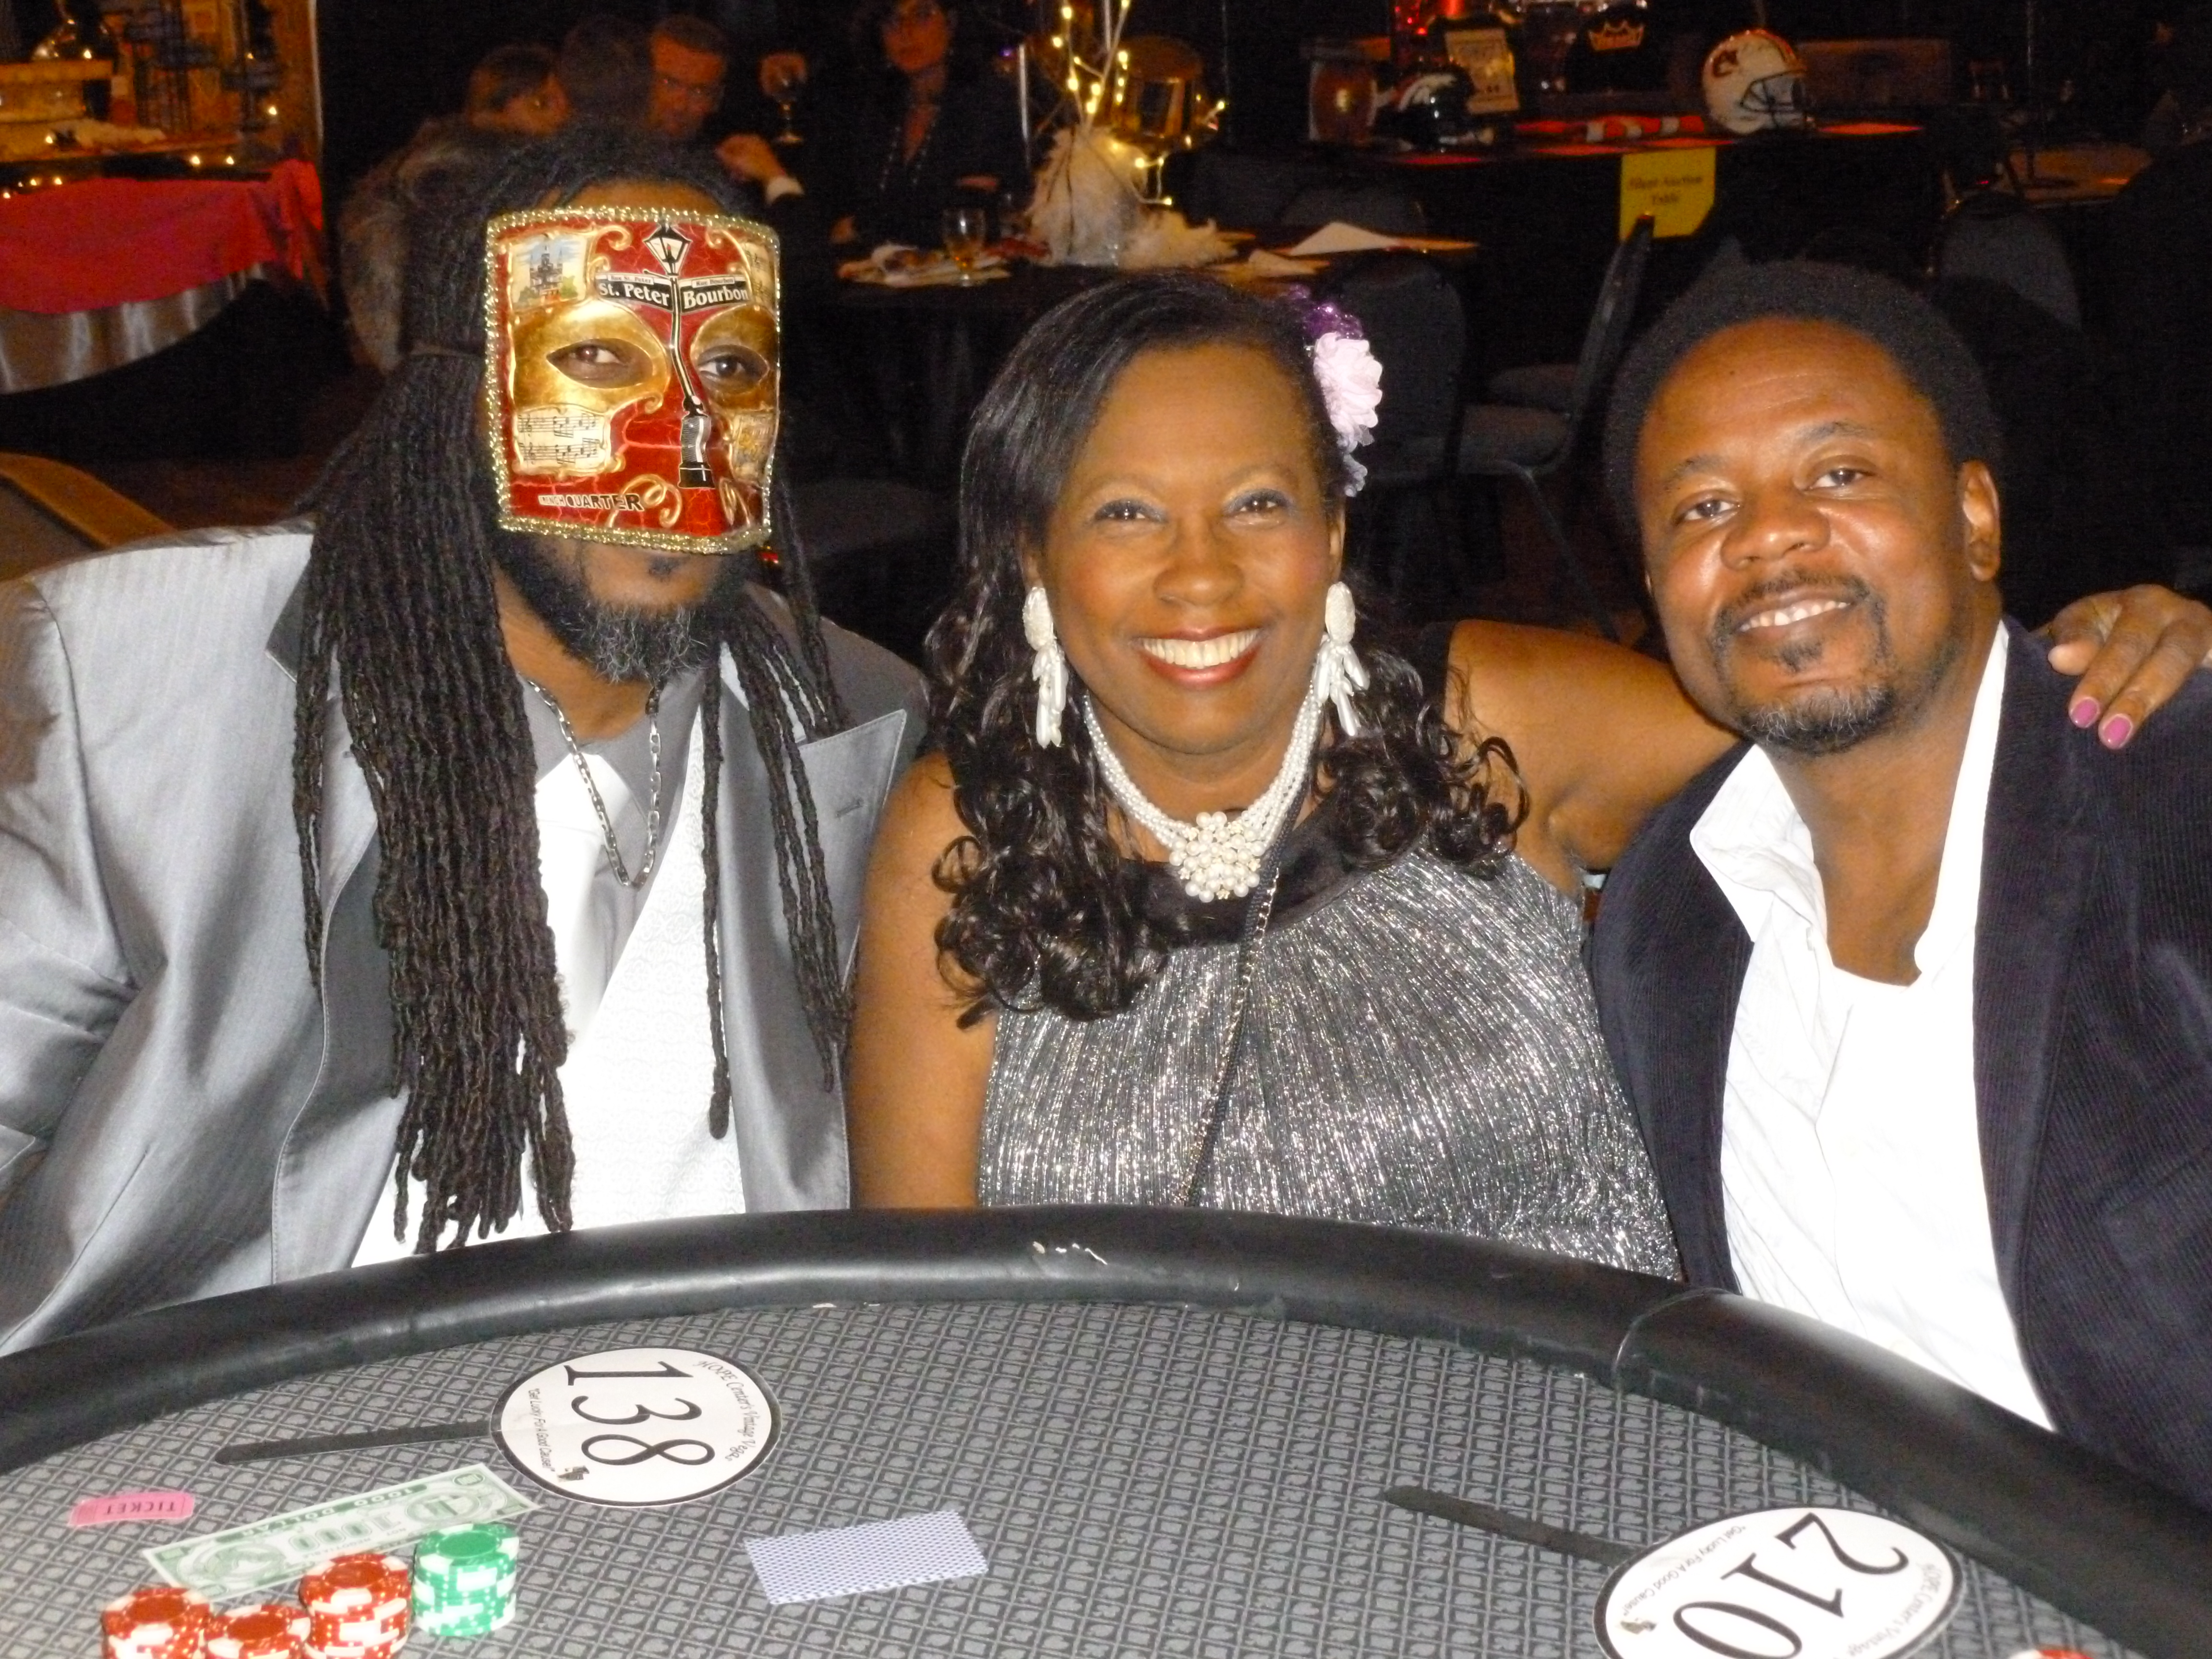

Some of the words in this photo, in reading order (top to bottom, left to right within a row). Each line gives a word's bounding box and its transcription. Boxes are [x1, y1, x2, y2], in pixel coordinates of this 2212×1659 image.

[599, 283, 620, 296] St.
[624, 283, 670, 306] Peter
[683, 286, 748, 309] Bourbon
[539, 496, 565, 506] NCH
[566, 494, 645, 511] QUARTER
[693, 1360, 738, 1381] HOPE
[726, 1382, 755, 1410] Center's
[529, 1400, 543, 1416] Lucky
[564, 1360, 715, 1466] 138
[534, 1418, 546, 1428] For
[737, 1410, 760, 1437] Vintage
[536, 1432, 551, 1447] Good
[724, 1439, 756, 1462] Vegas
[354, 1488, 413, 1506] 1000
[101, 1502, 179, 1515] TICKET
[289, 1512, 400, 1553] 1000
[385, 1527, 407, 1537] NOT
[1698, 1536, 1727, 1556] Lucky
[1676, 1562, 1687, 1572] A
[1685, 1554, 1703, 1567] For
[1653, 1570, 1679, 1590] Good
[1672, 1512, 1909, 1659] 210
